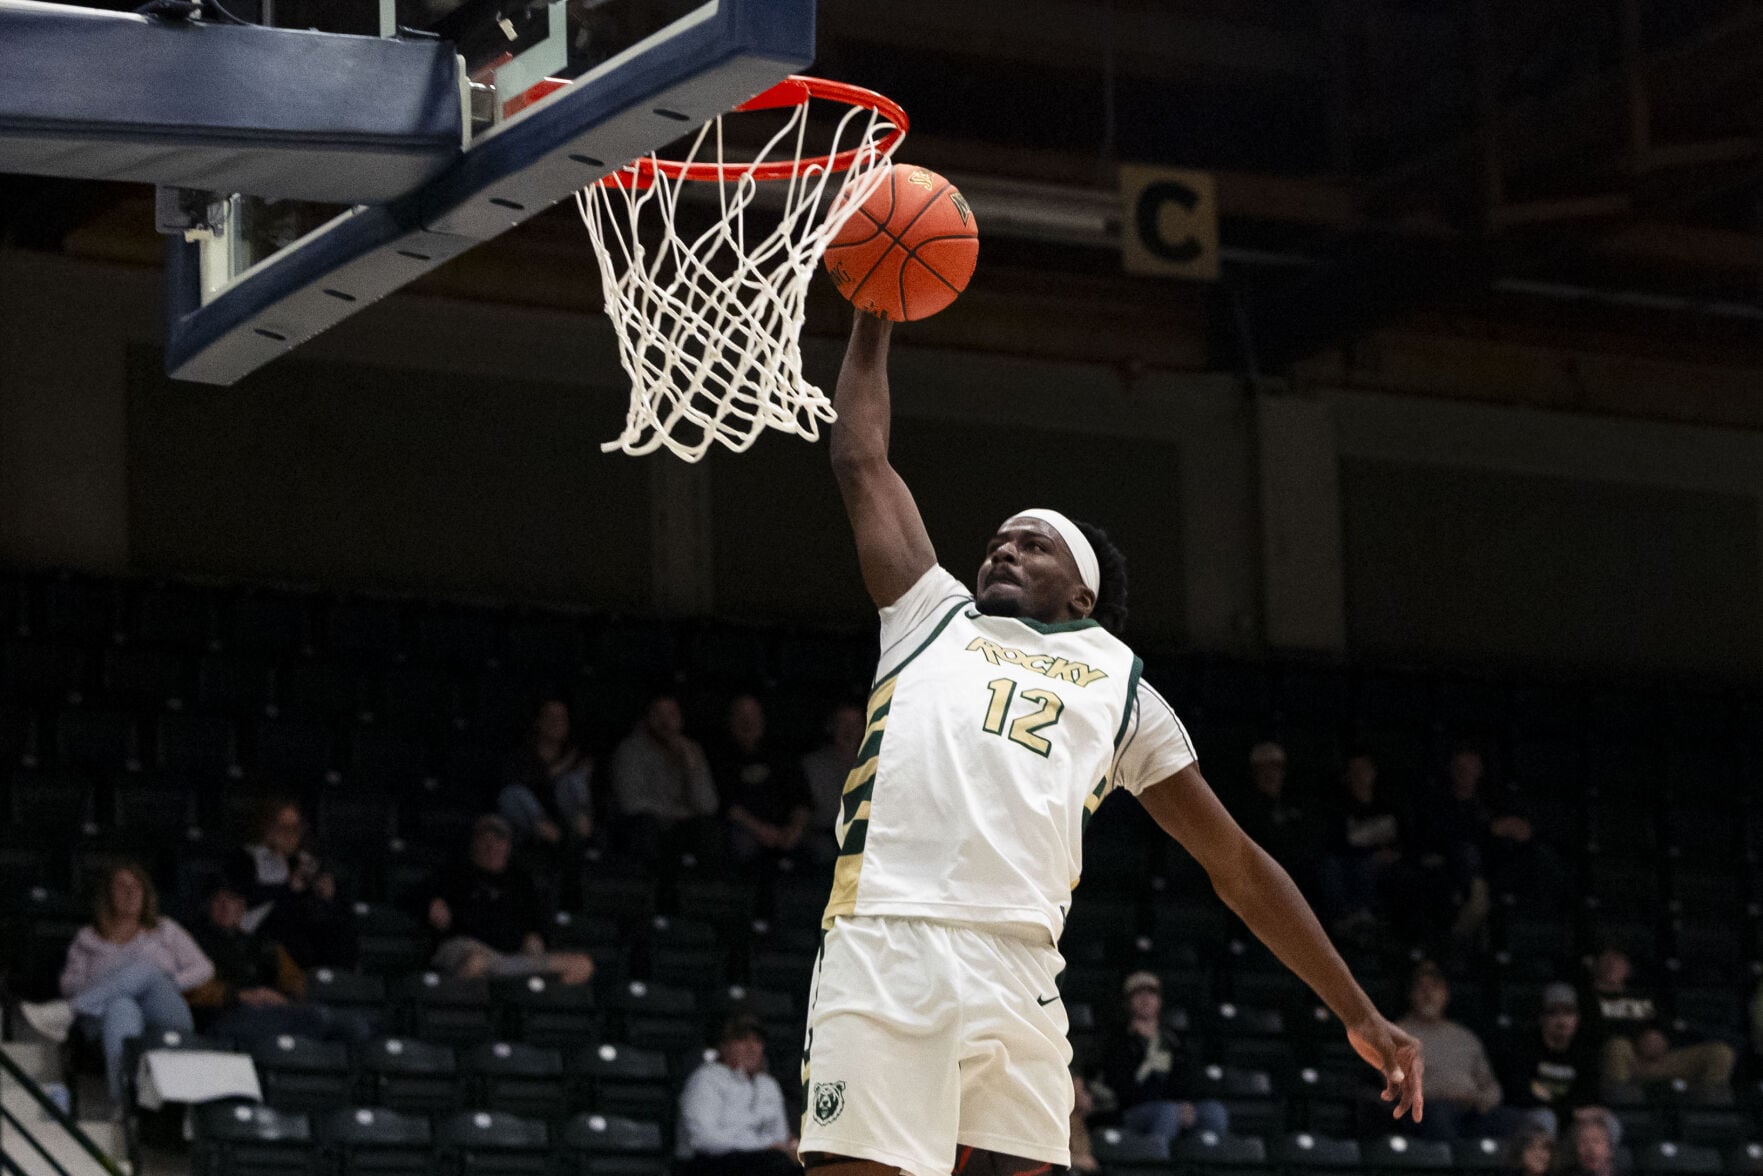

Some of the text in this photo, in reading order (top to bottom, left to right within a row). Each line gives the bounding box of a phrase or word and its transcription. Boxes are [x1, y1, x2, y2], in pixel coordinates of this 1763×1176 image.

[1137, 181, 1202, 261] C
[965, 636, 1109, 688] ROCKY
[982, 677, 1065, 759] 12
